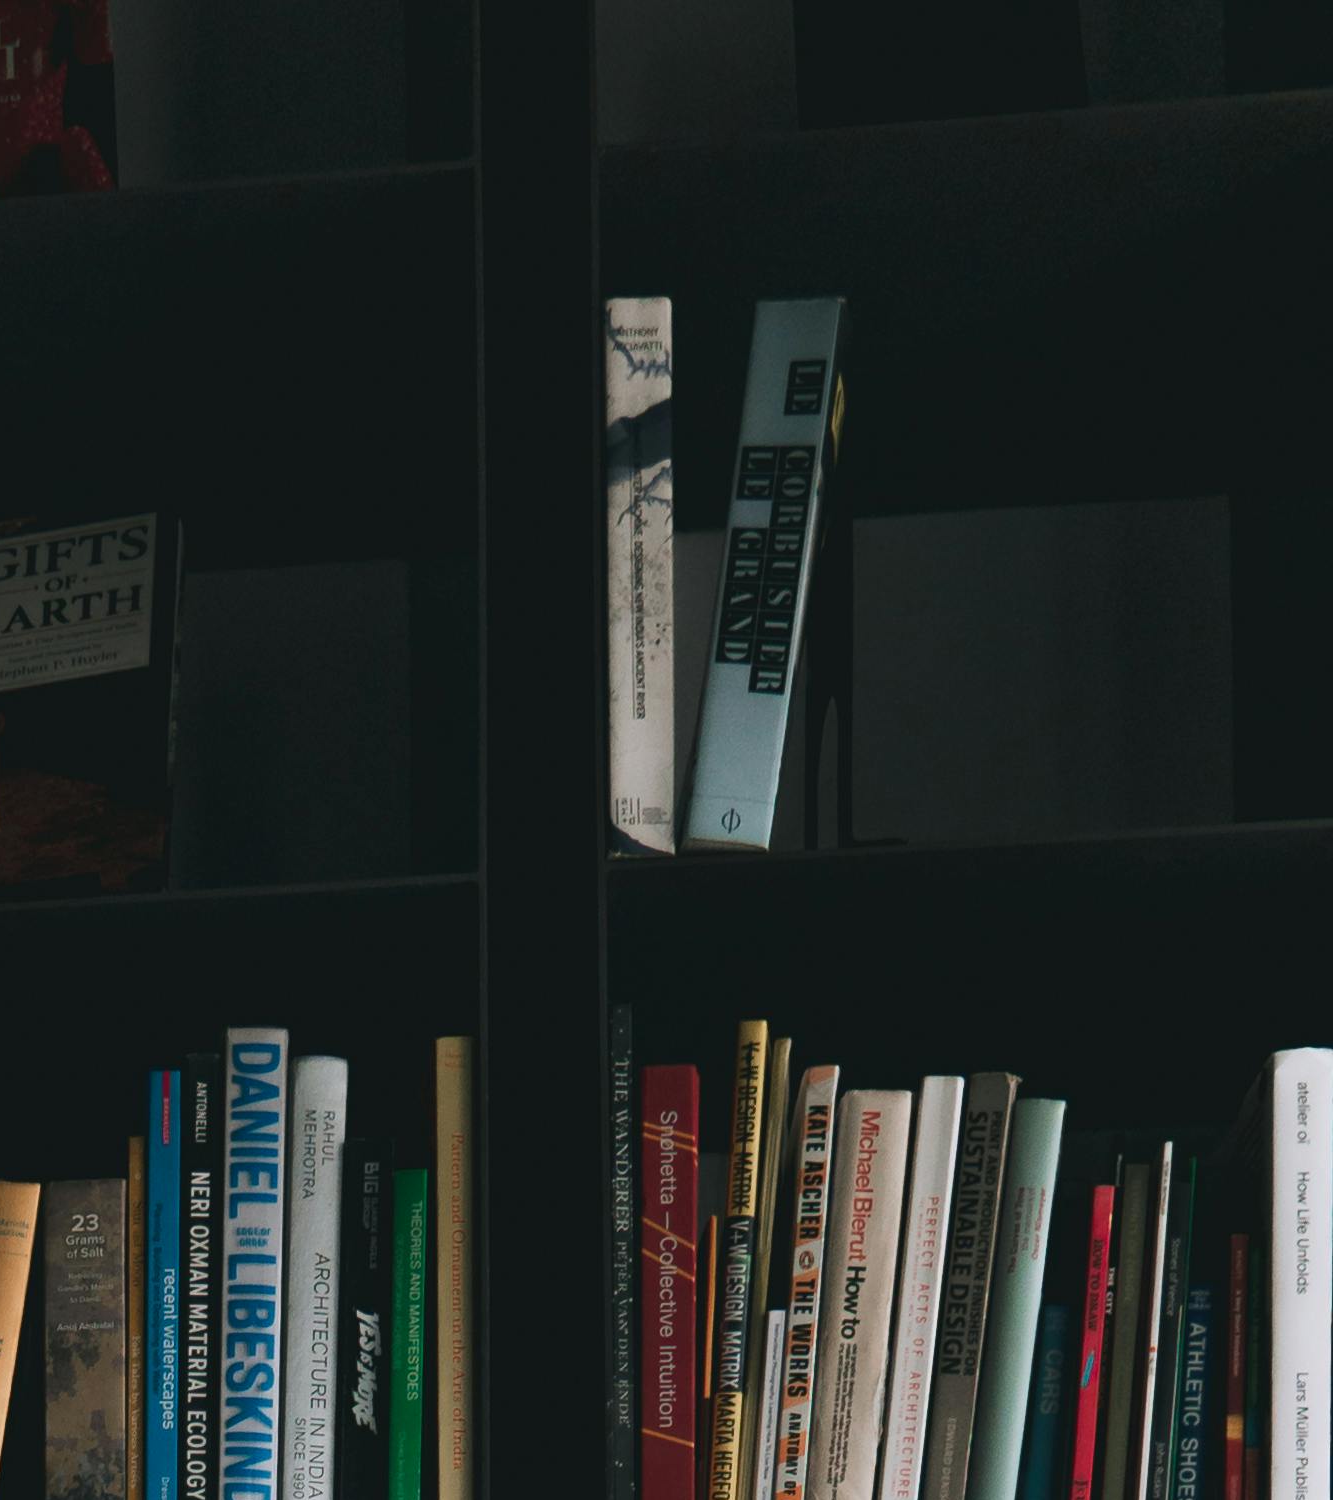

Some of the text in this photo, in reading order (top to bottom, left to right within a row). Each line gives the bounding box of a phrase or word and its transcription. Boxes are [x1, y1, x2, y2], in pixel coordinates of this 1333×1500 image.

[44, 574, 78, 594] OF
[723, 452, 773, 661] LE GRAND
[754, 364, 823, 692] LE CORBUSIER
[194, 1082, 208, 1143] ANTONELLI
[229, 1042, 280, 1219] DANIEL
[302, 1110, 317, 1199] MEHROTRA
[321, 1110, 335, 1165] RAHUL
[799, 1105, 828, 1240] KATE ASCHER
[657, 1111, 679, 1428] Snøhetta Collective Intuition
[841, 1111, 881, 1339] Michael Bierut How to
[185, 1171, 212, 1500] NERI OXMAN MATERIAL ECOLOGY
[307, 1253, 329, 1499] ARCHITECTURE IN INDIA
[787, 1279, 816, 1398] THE WORKS
[1183, 1322, 1206, 1425] ATHLETIC
